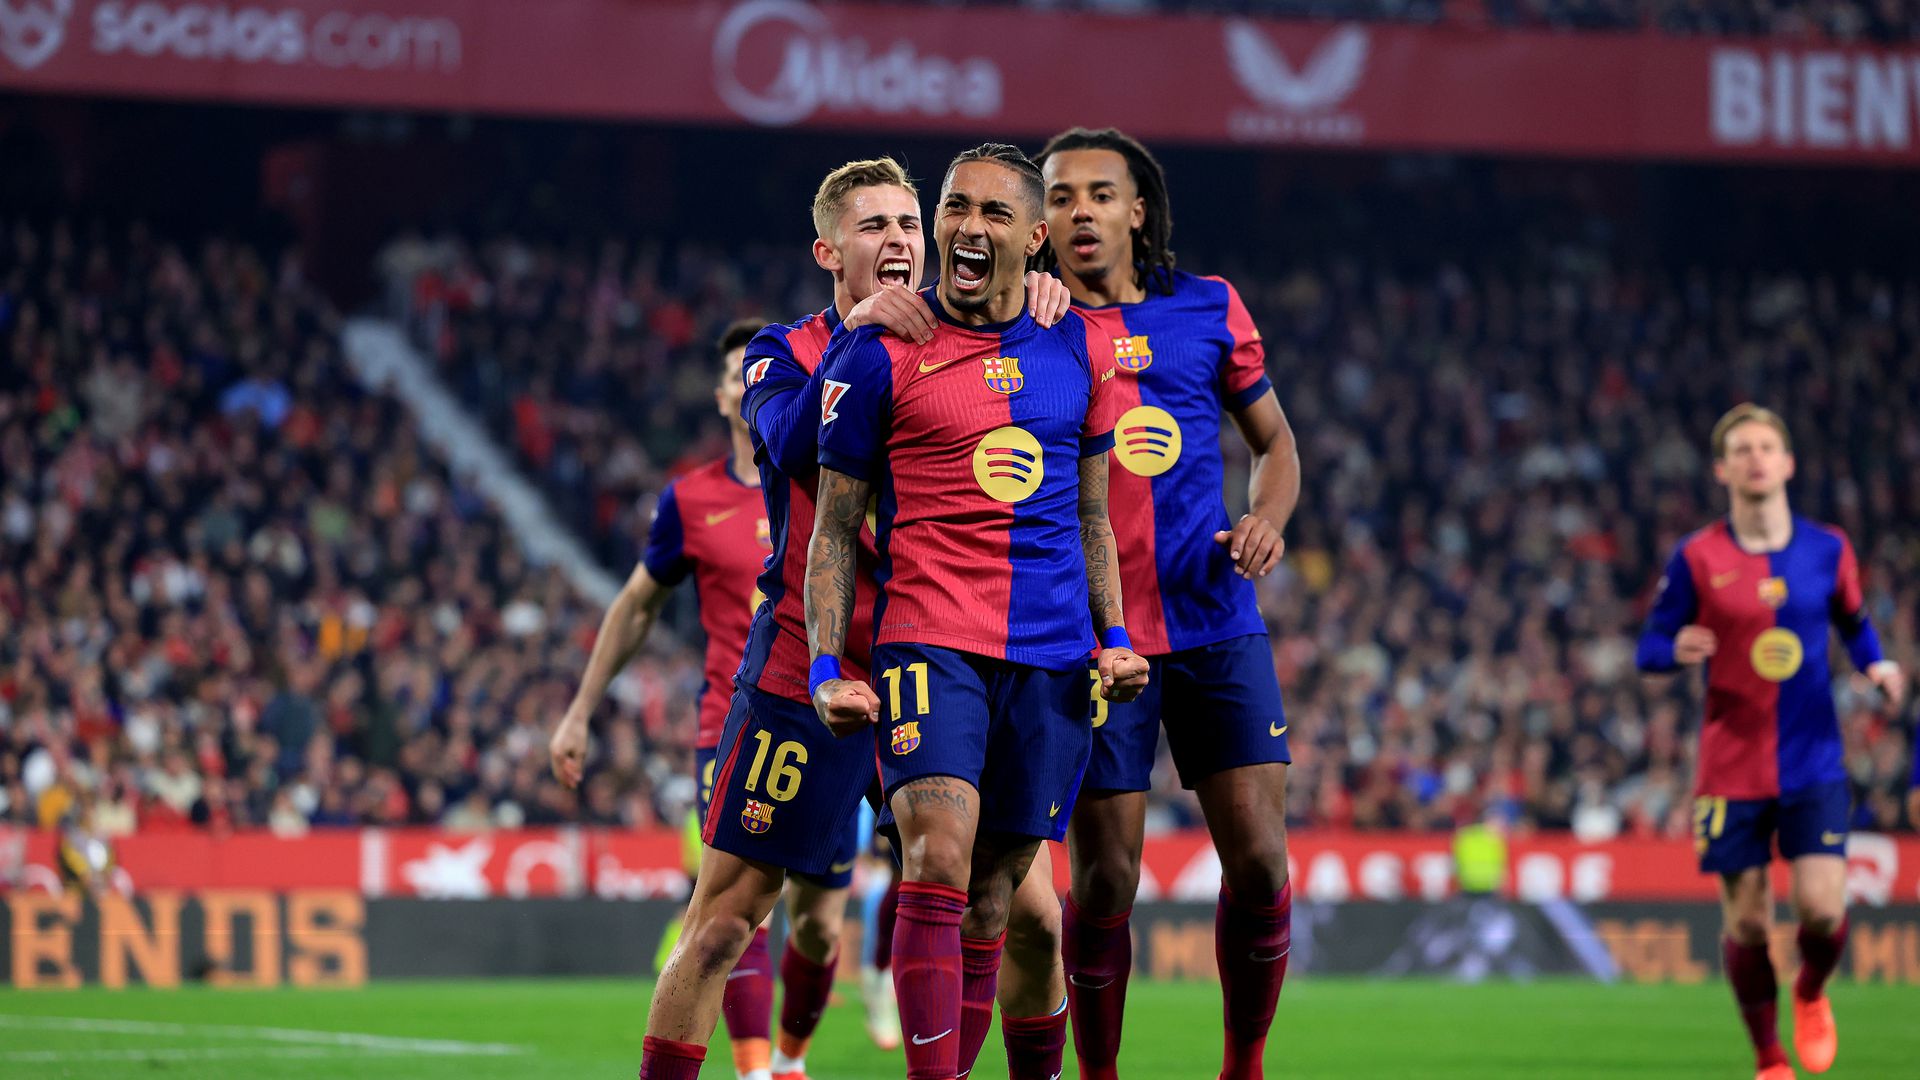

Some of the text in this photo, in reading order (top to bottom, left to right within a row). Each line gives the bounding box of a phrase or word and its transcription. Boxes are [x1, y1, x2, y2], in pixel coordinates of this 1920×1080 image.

[1711, 47, 1920, 150] BIEN
[881, 662, 930, 722] 11
[744, 729, 808, 802] 16
